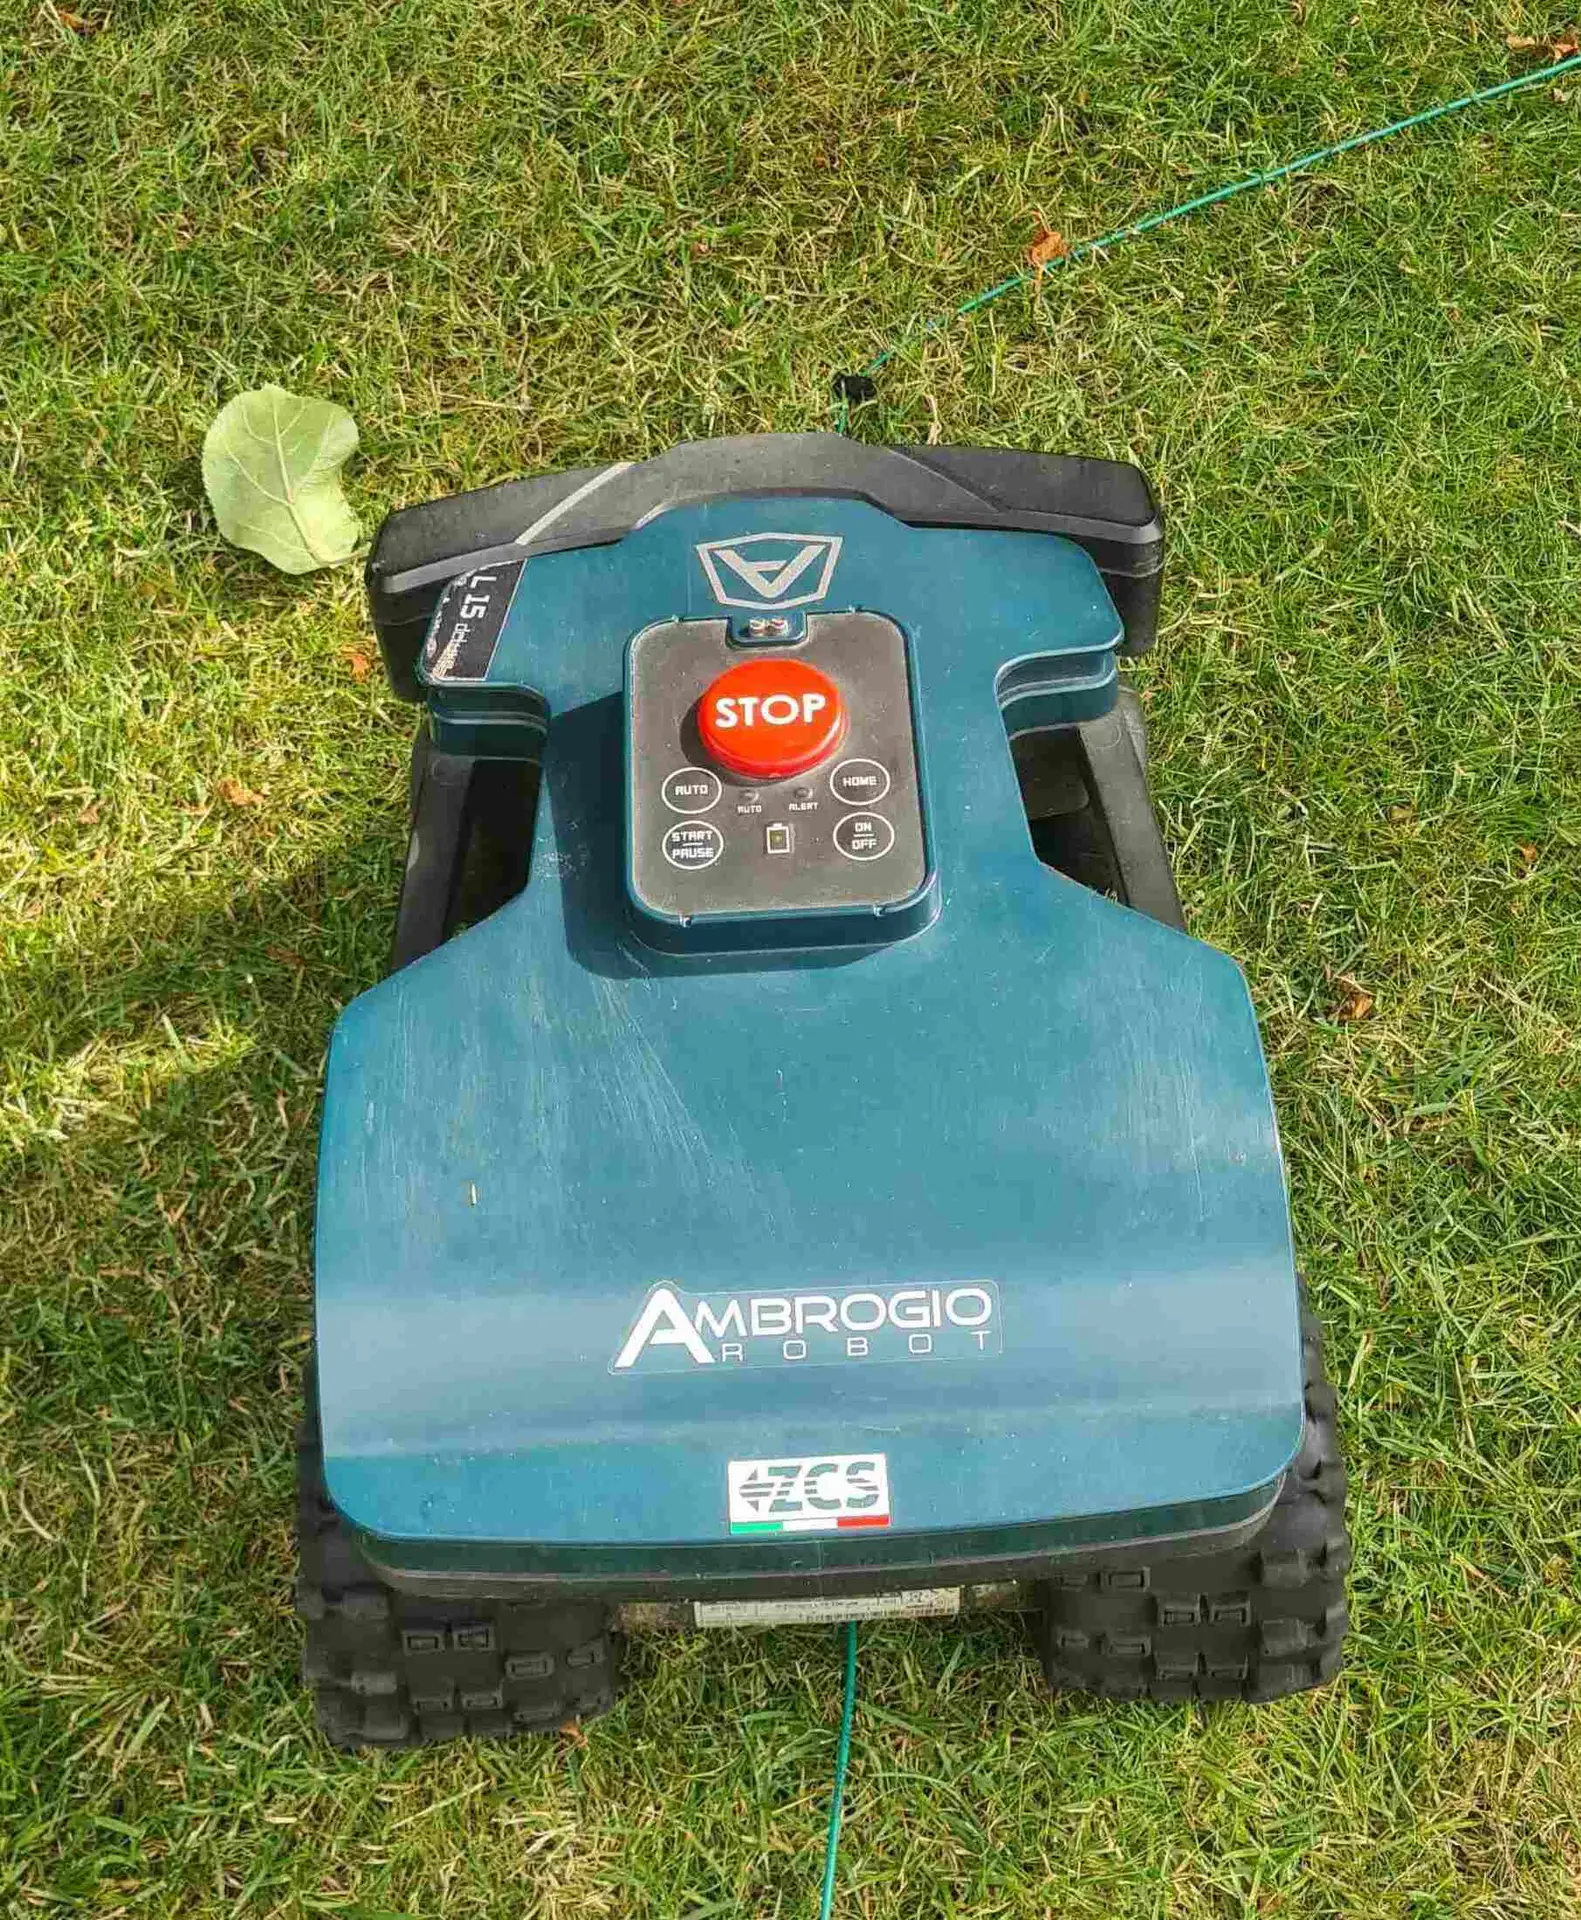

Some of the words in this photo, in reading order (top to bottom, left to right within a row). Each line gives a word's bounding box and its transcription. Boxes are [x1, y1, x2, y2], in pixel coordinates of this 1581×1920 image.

[470, 575, 497, 589] L
[460, 593, 490, 619] 15
[715, 693, 827, 728] STOP
[842, 775, 877, 788] HOME
[674, 784, 709, 796] AUTO
[737, 804, 763, 814] AUTO
[788, 801, 819, 812] ALERT
[855, 822, 872, 833] ON
[671, 830, 713, 842] START
[852, 839, 877, 850] OFF
[671, 847, 714, 860] PAUSE
[615, 1287, 993, 1368] AMBROGIO
[721, 1330, 992, 1363] ROBOT
[767, 1460, 880, 1513] ZCS
